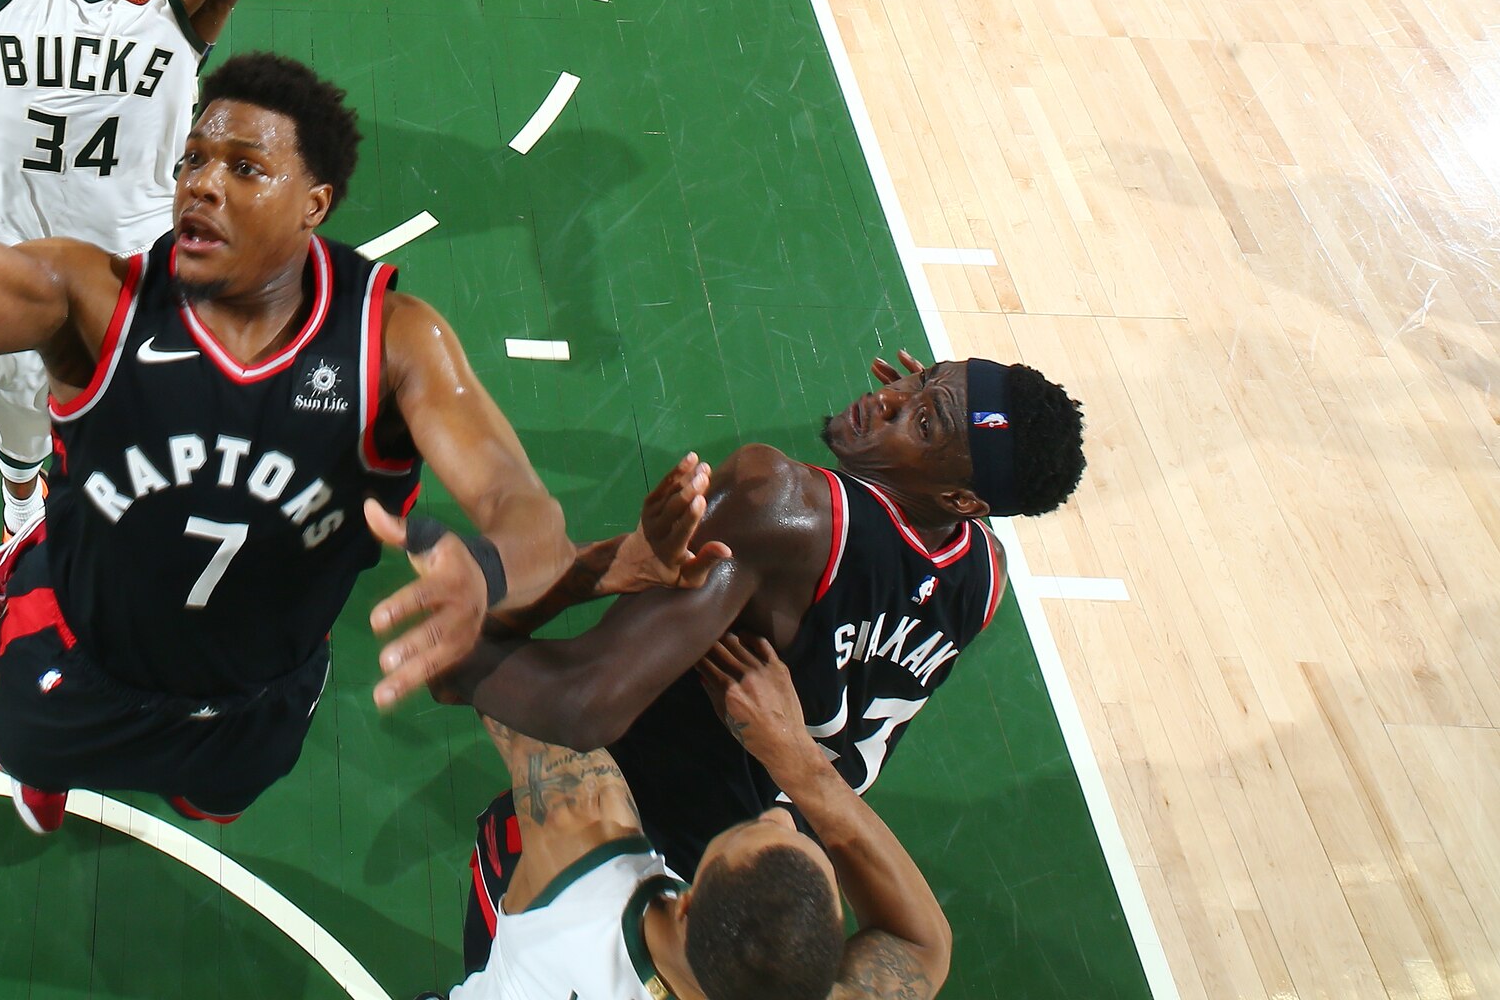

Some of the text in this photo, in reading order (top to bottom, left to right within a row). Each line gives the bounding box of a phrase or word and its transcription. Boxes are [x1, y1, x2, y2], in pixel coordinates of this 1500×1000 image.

[21, 108, 121, 177] 34
[293, 394, 349, 412] Sun Life
[82, 433, 346, 549] RAPTORS
[183, 515, 249, 610] 7
[834, 612, 960, 687] SIAKAM
